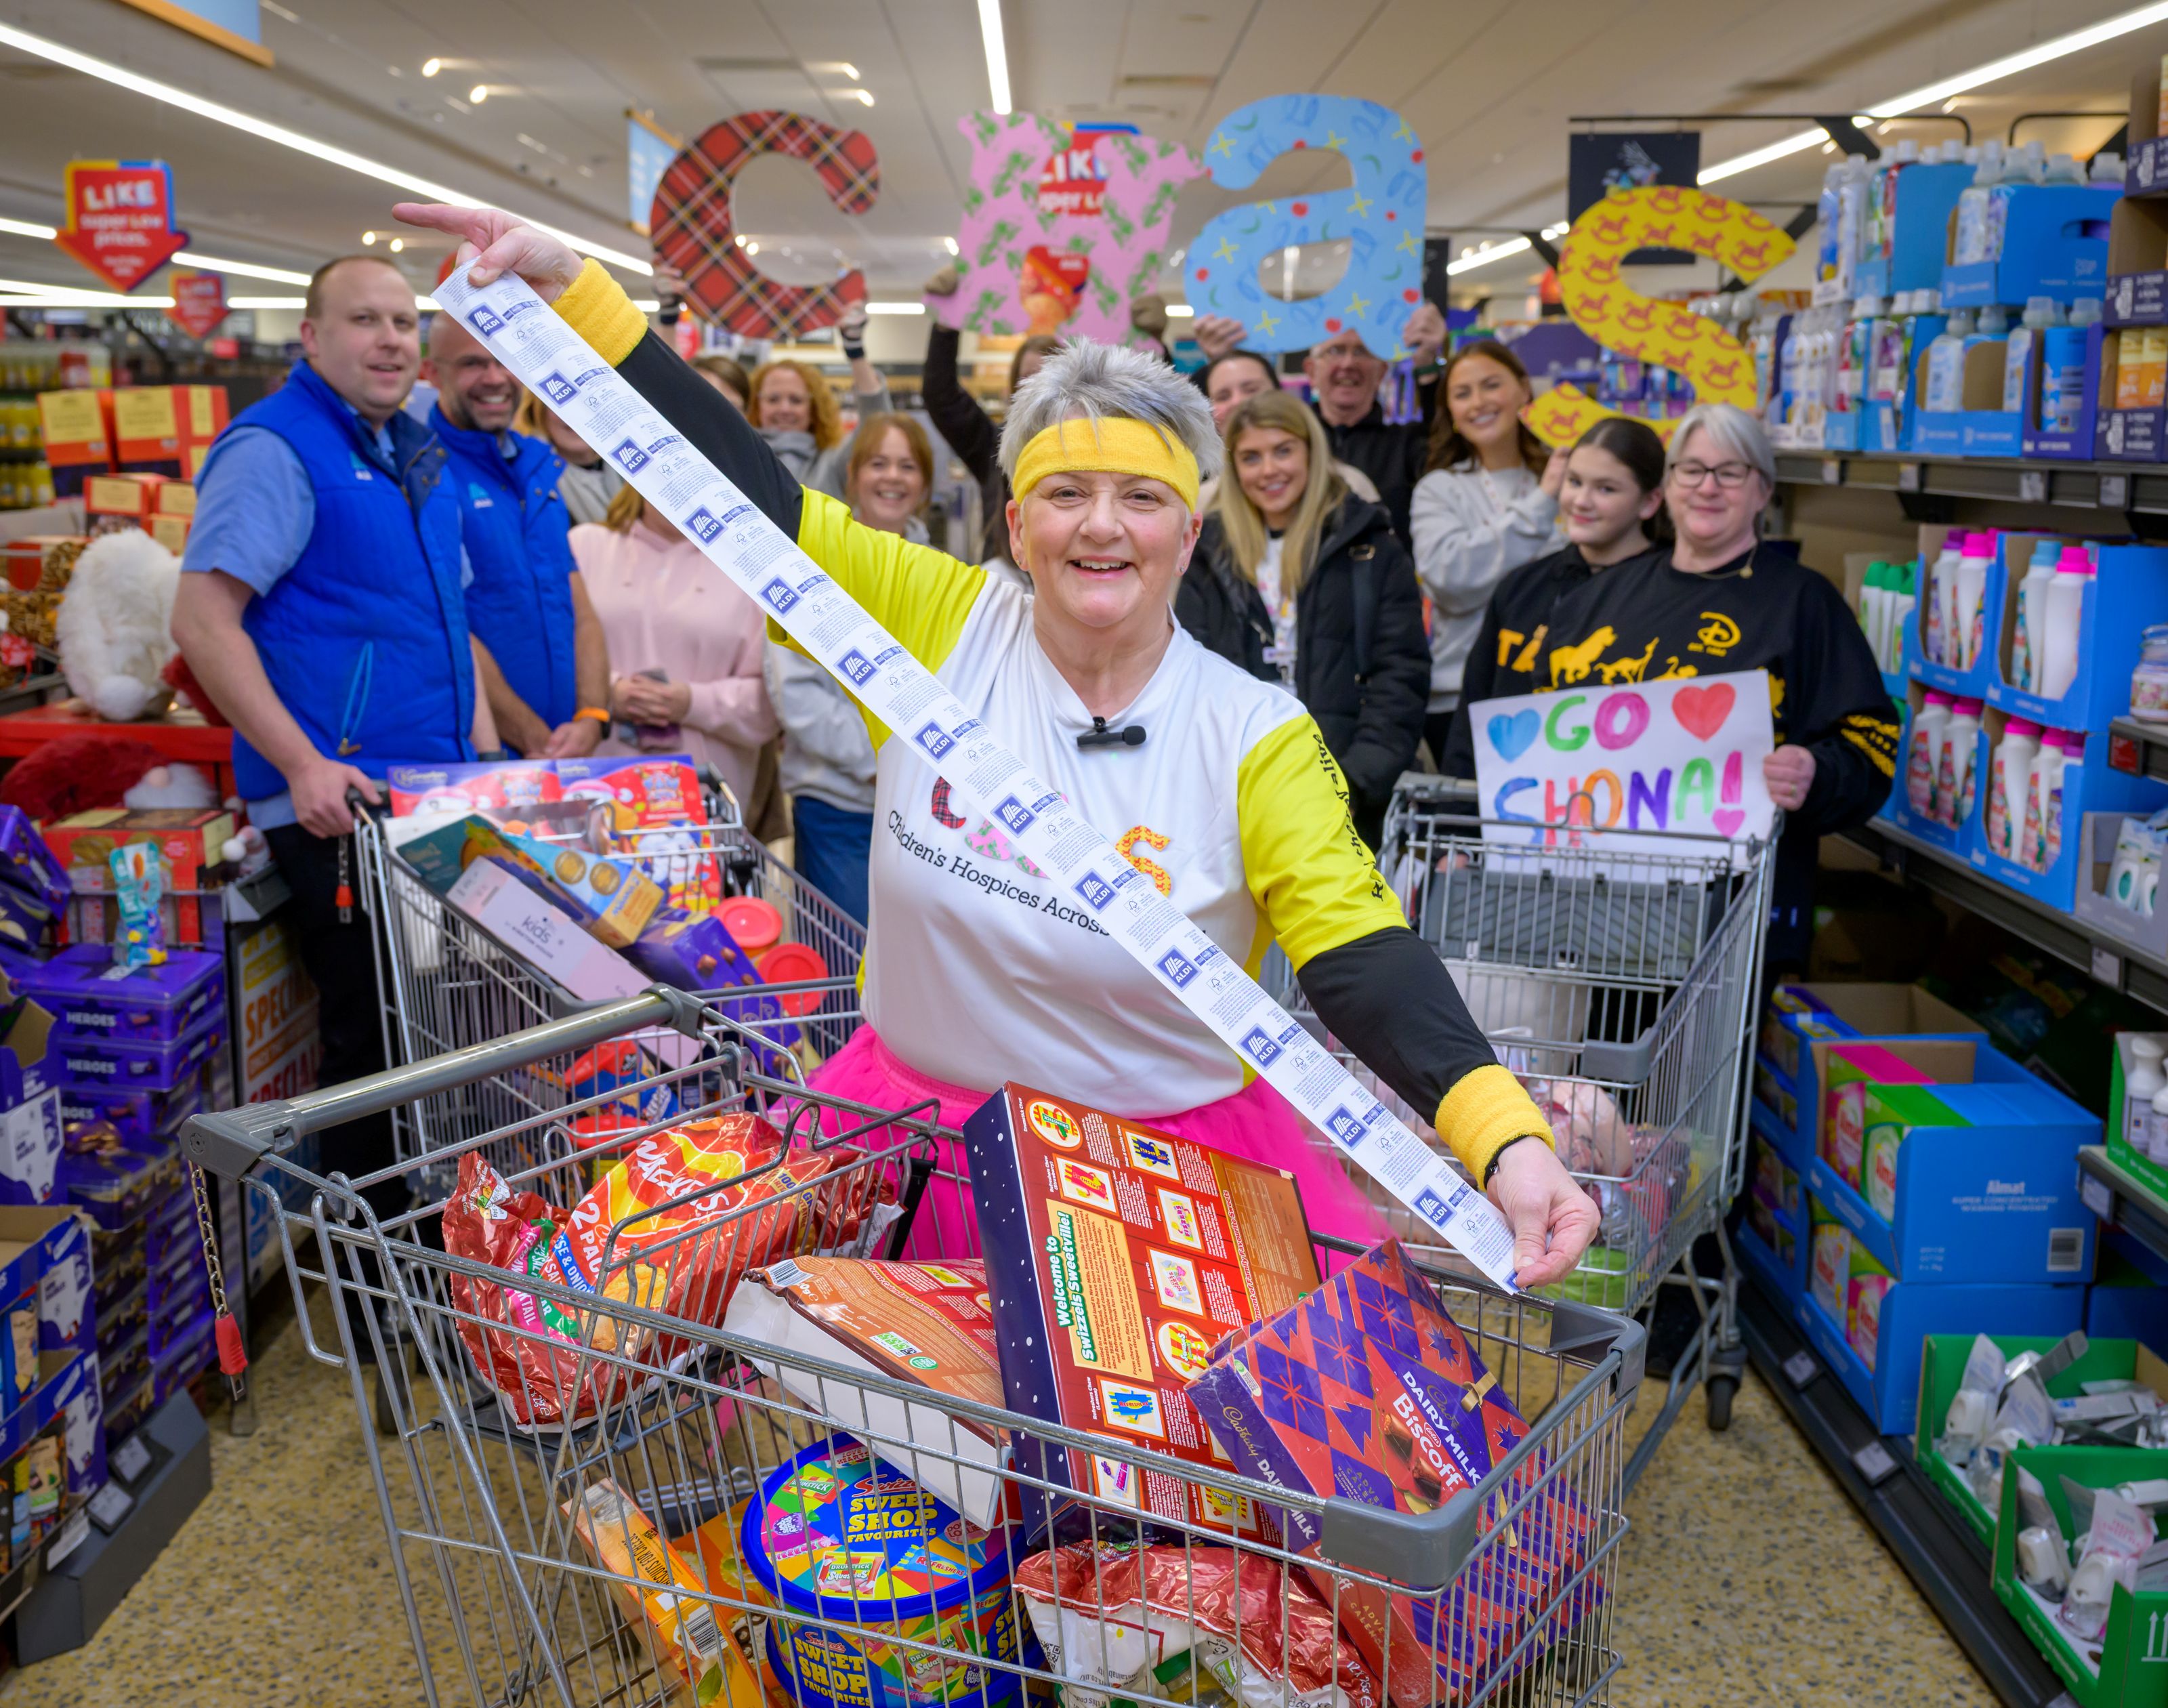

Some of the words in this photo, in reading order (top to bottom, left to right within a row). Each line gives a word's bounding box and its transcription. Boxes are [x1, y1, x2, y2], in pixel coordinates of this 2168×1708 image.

[83, 180, 156, 211] LIKE
[483, 319, 500, 333] ALDI
[555, 386, 572, 402] ALDI
[627, 453, 645, 470] ALDI
[701, 522, 720, 539] ALDI
[778, 593, 795, 610] ALDI
[854, 664, 872, 682] ALDI
[1545, 692, 1650, 751] GO
[932, 737, 950, 755] ALDI
[1313, 732, 1337, 784] alive
[1494, 750, 1746, 856] SHONA!
[1012, 813, 1030, 829] ALDI
[948, 855, 1040, 908] Hospices
[1093, 888, 1110, 905] ALDI
[520, 914, 554, 945] kids
[1175, 965, 1193, 983] ALDI
[66, 1012, 117, 1027] HEROES
[1258, 1044, 1276, 1062] ALDI
[67, 1059, 117, 1074] HEROES
[1043, 1114, 1069, 1129] DRUMSTICK
[1344, 1125, 1361, 1142] ALDI
[1049, 1161, 1058, 1190] (Strawberry)
[1986, 1180, 2025, 1194] Almat
[1222, 1189, 1235, 1218] Sweets
[1432, 1205, 1448, 1222] ALDI
[1085, 1213, 1093, 1241] Drumsticks,
[1175, 1203, 1190, 1237] FIZZERS
[1046, 1236, 1058, 1254] to
[1056, 1211, 1079, 1290] Sweetville!
[1232, 1219, 1246, 1259] Favourite
[1103, 1259, 1111, 1287] excitement
[1168, 1270, 1182, 1292] HEARTS
[1240, 1258, 1253, 1285] Family
[1050, 1255, 1070, 1327] Welcome
[864, 1262, 884, 1283] Advent
[881, 1280, 908, 1299] Calendar
[906, 1297, 937, 1318] Containing
[946, 1322, 978, 1353] Assortment
[1069, 1293, 1093, 1358] Swizzels
[1146, 1316, 1154, 1341] Drumstick
[1151, 1341, 1159, 1367] Squashies
[1089, 1392, 1097, 1419] Refreshers
[1223, 1406, 1260, 1455] Cadbury
[1402, 1371, 1449, 1432] DAIRY
[1444, 1433, 1482, 1487] MILK
[842, 1448, 862, 1459] LOVE
[850, 1493, 936, 1513] SWEET
[848, 1509, 938, 1533] SHOP
[848, 1528, 936, 1543] FAVOURITES
[636, 1550, 656, 1566] FOR
[1362, 1605, 1394, 1646] ADVET
[795, 1637, 864, 1671] SWEET
[797, 1656, 868, 1694] SHOP
[1347, 1661, 1360, 1673] 12
[804, 1677, 871, 1707] FAVOURITES
